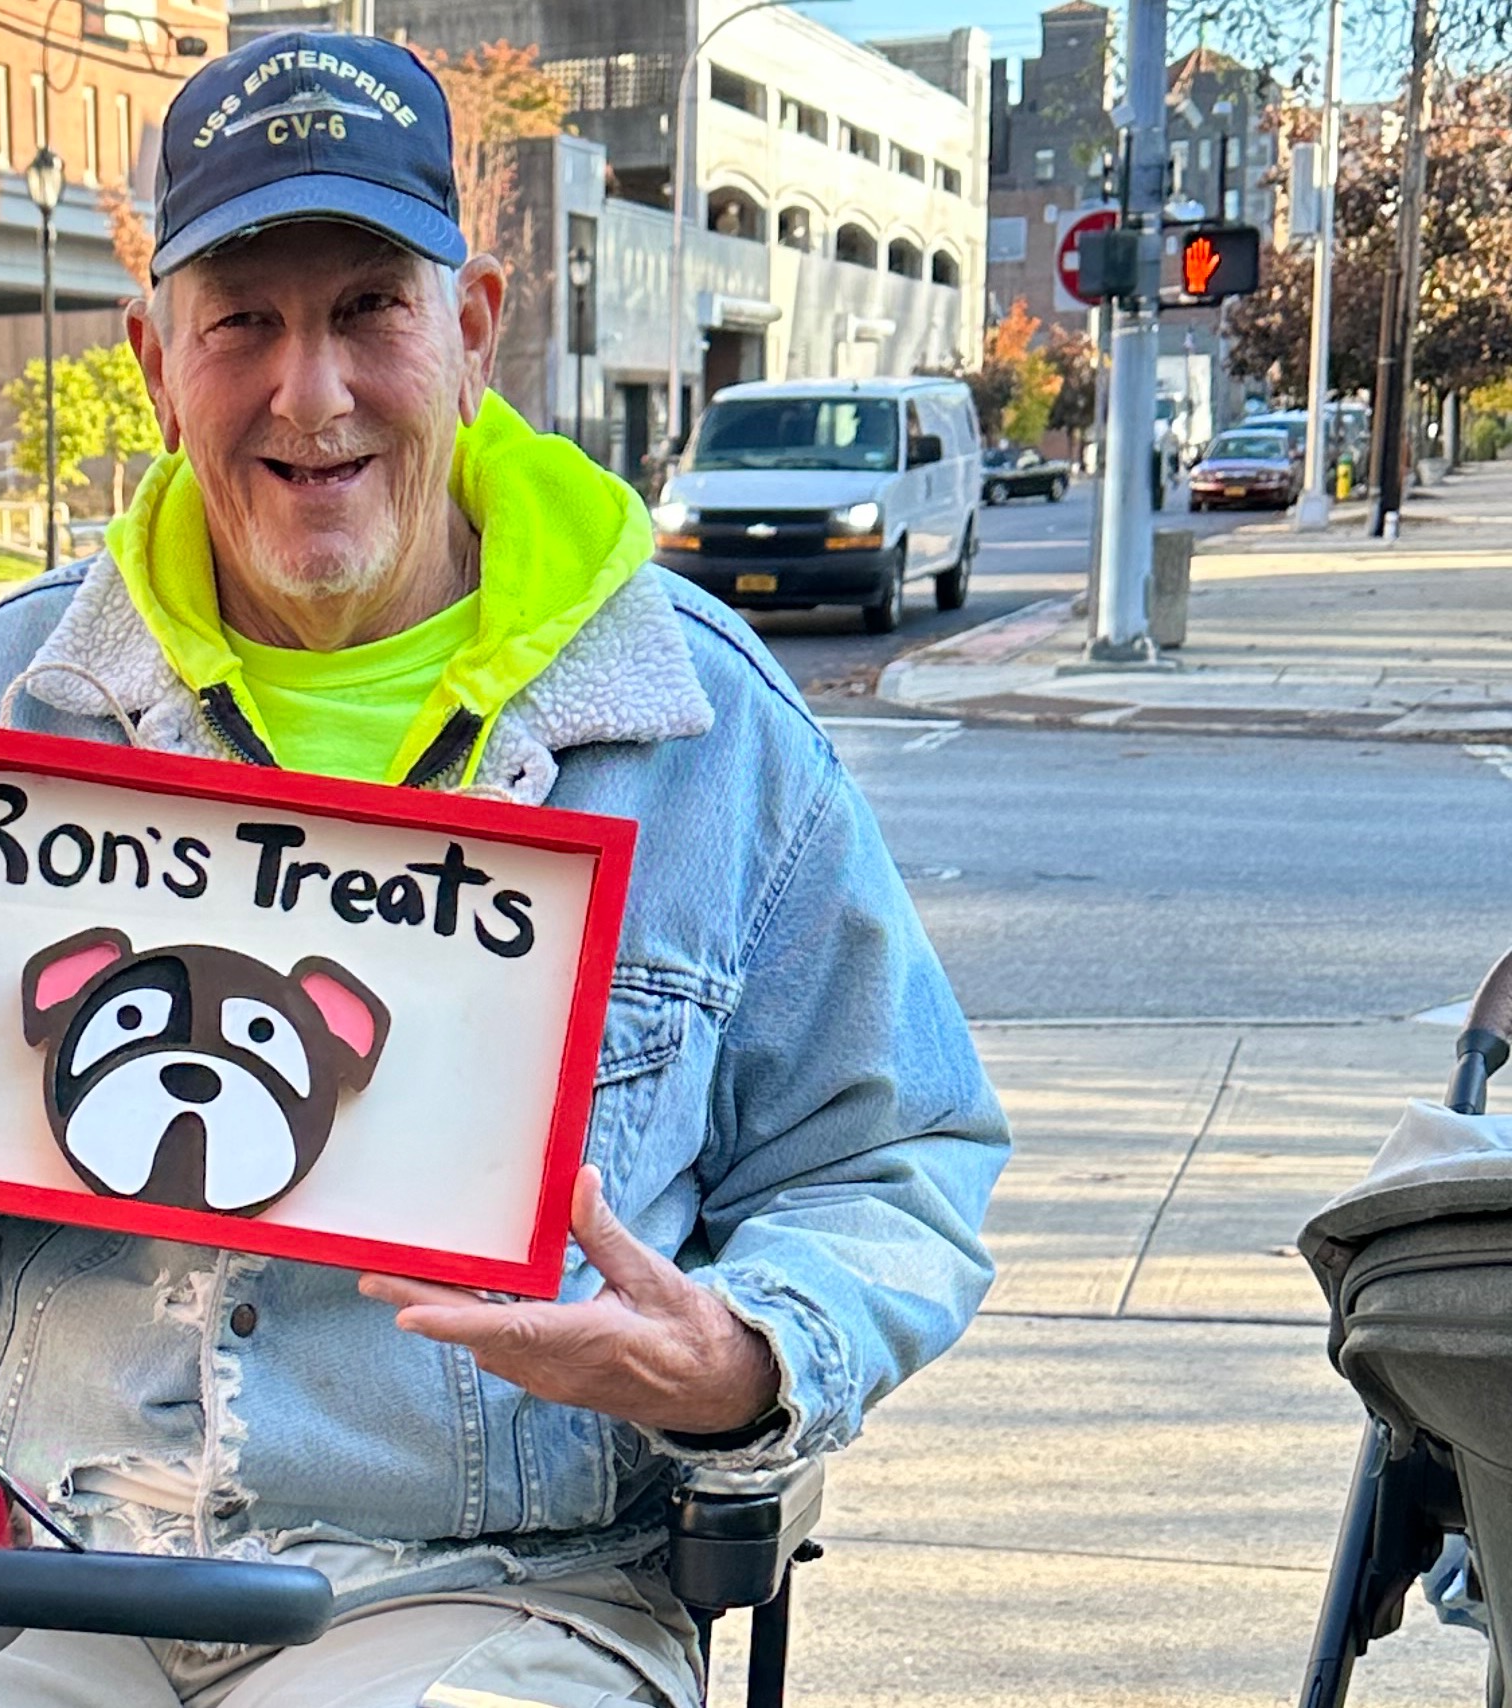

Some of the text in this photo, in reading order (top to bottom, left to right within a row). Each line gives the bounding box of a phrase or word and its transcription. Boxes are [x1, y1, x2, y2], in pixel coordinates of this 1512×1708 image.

[193, 50, 418, 148] USS ENTERPRISE
[266, 113, 348, 145] CV-6
[236, 823, 535, 958] Treats
